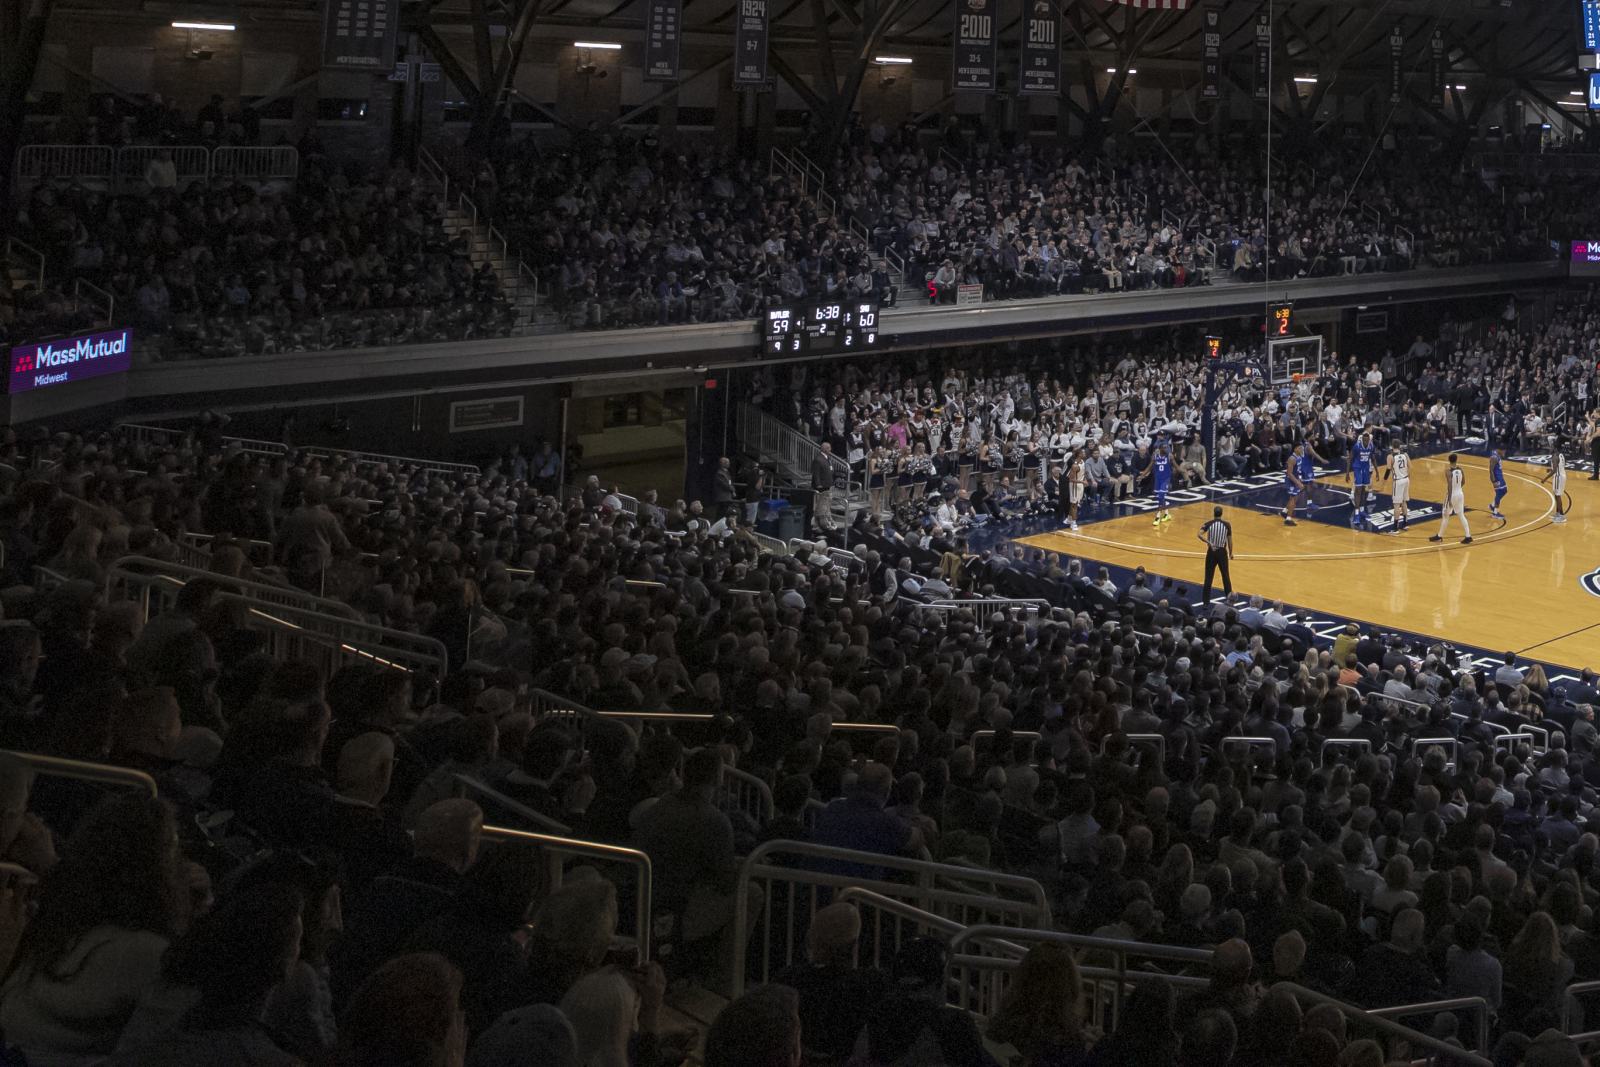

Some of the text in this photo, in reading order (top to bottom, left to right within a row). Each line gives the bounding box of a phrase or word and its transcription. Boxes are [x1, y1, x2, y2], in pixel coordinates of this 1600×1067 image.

[742, 0, 766, 17] 1924
[961, 15, 991, 38] 2010
[1029, 19, 1054, 43] 2011
[1205, 33, 1219, 46] 1929
[422, 72, 439, 81] 223
[770, 311, 790, 319] BUTLER
[816, 306, 840, 319] 6:38
[1276, 309, 1290, 319] 6:38
[860, 314, 874, 327] 60
[773, 320, 789, 333] 59
[820, 324, 826, 333] 2
[1280, 318, 1288, 334] 2
[845, 336, 851, 345] 2
[868, 334, 874, 343] 8
[775, 342, 780, 350] 9
[793, 340, 799, 350] 3
[36, 332, 127, 369] MassMutual
[1212, 347, 1217, 357] 2
[34, 371, 68, 386] Midwest
[1398, 459, 1405, 469] 21
[1455, 474, 1459, 483] 1
